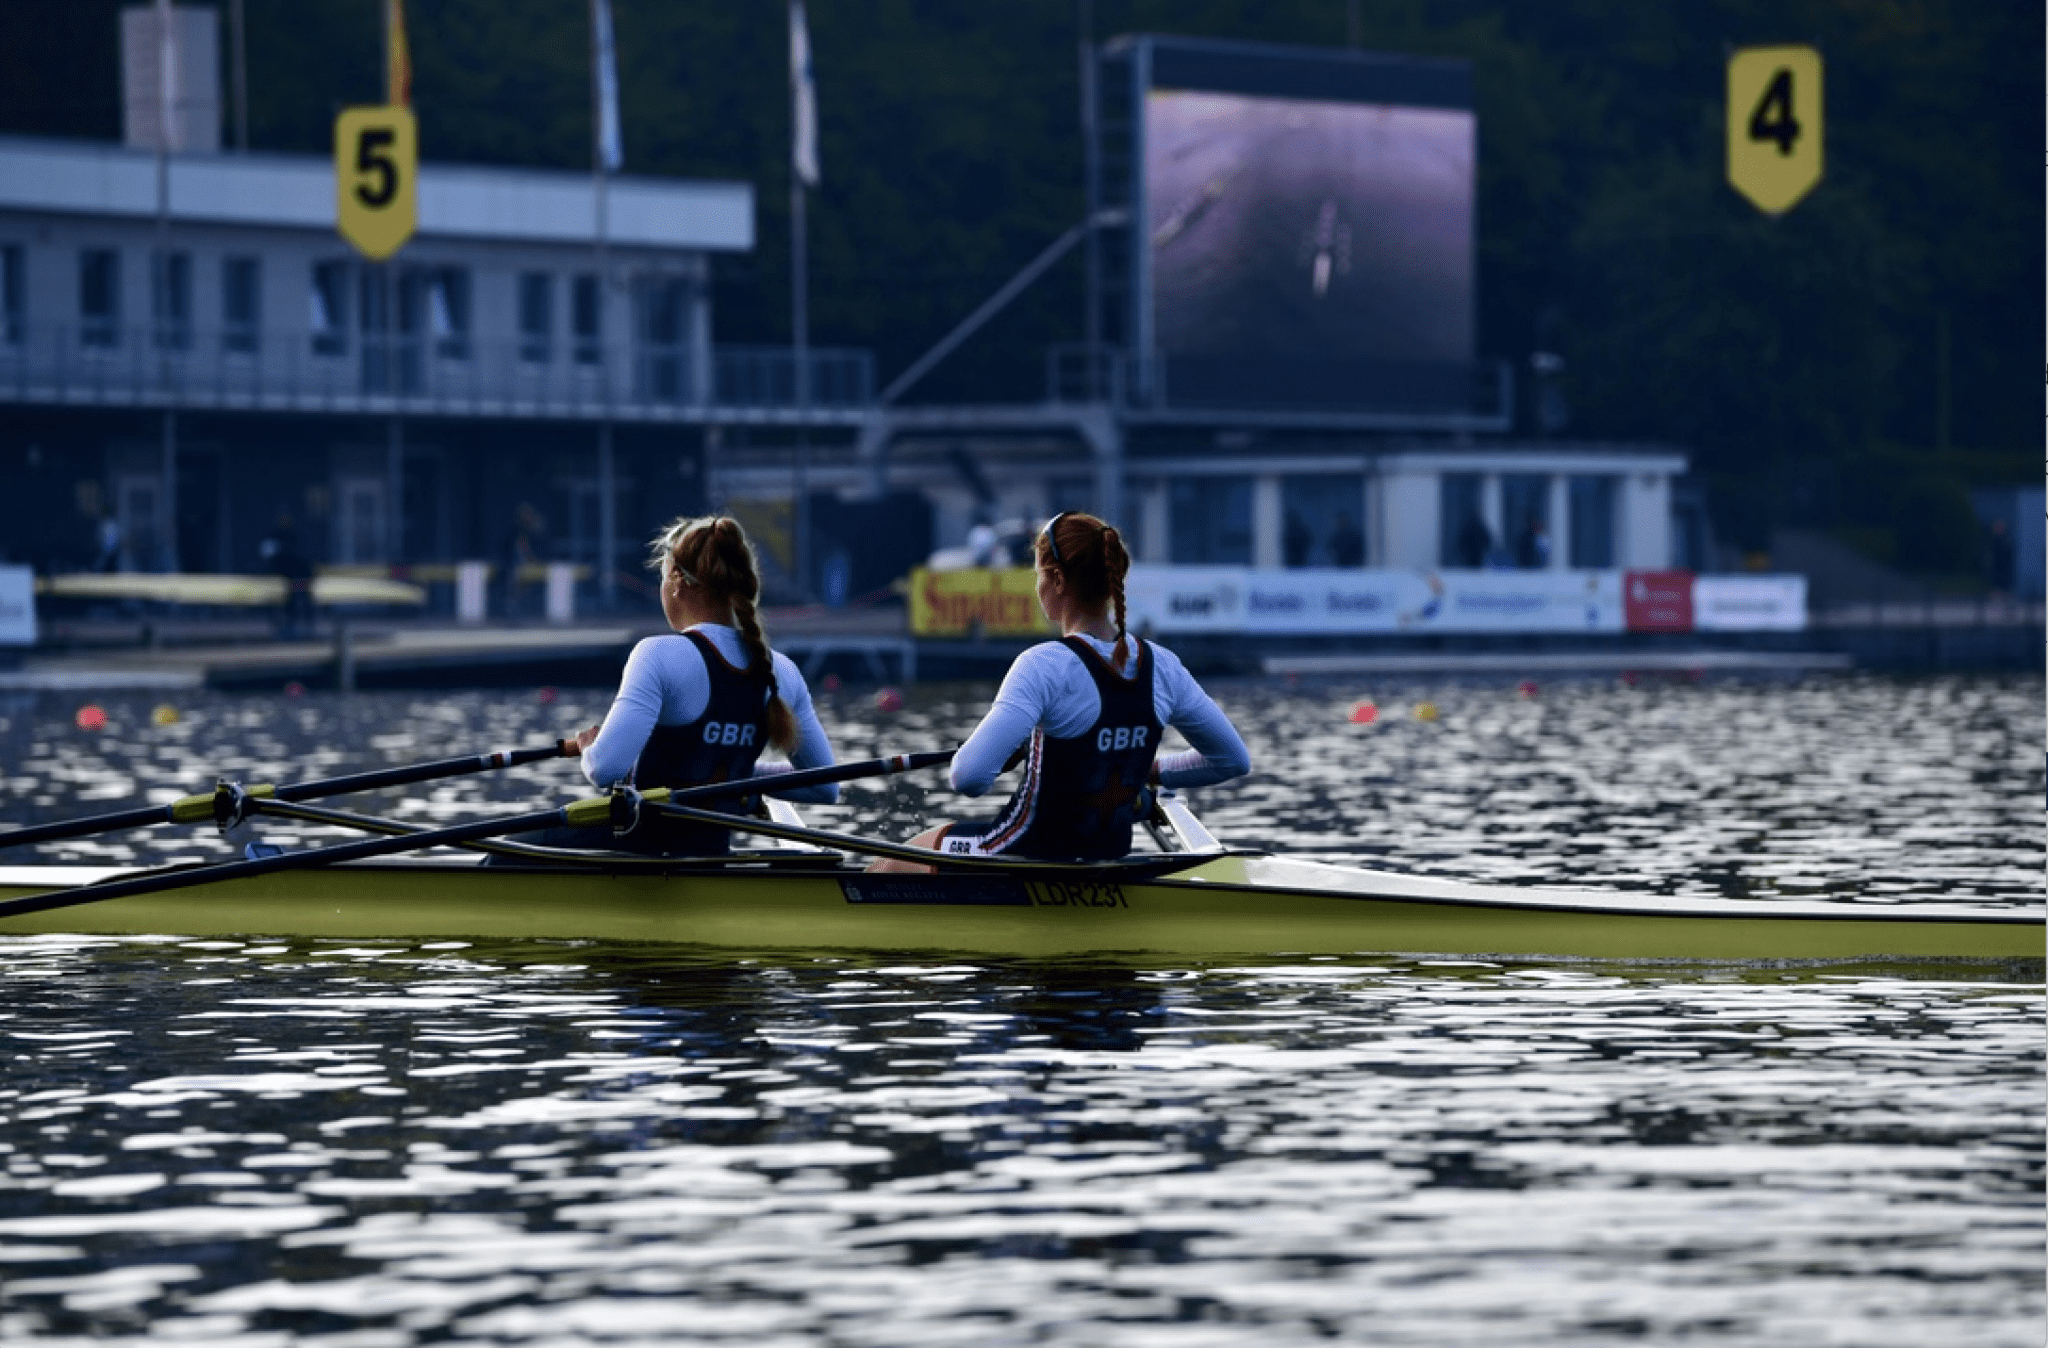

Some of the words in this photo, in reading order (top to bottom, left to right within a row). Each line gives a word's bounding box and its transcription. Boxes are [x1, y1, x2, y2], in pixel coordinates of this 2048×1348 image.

[1750, 68, 1799, 154] 4
[358, 130, 396, 207] 5
[703, 721, 757, 747] GBR
[1097, 725, 1149, 752] GBR
[948, 840, 972, 854] GBR
[1029, 880, 1128, 908] LDR231
